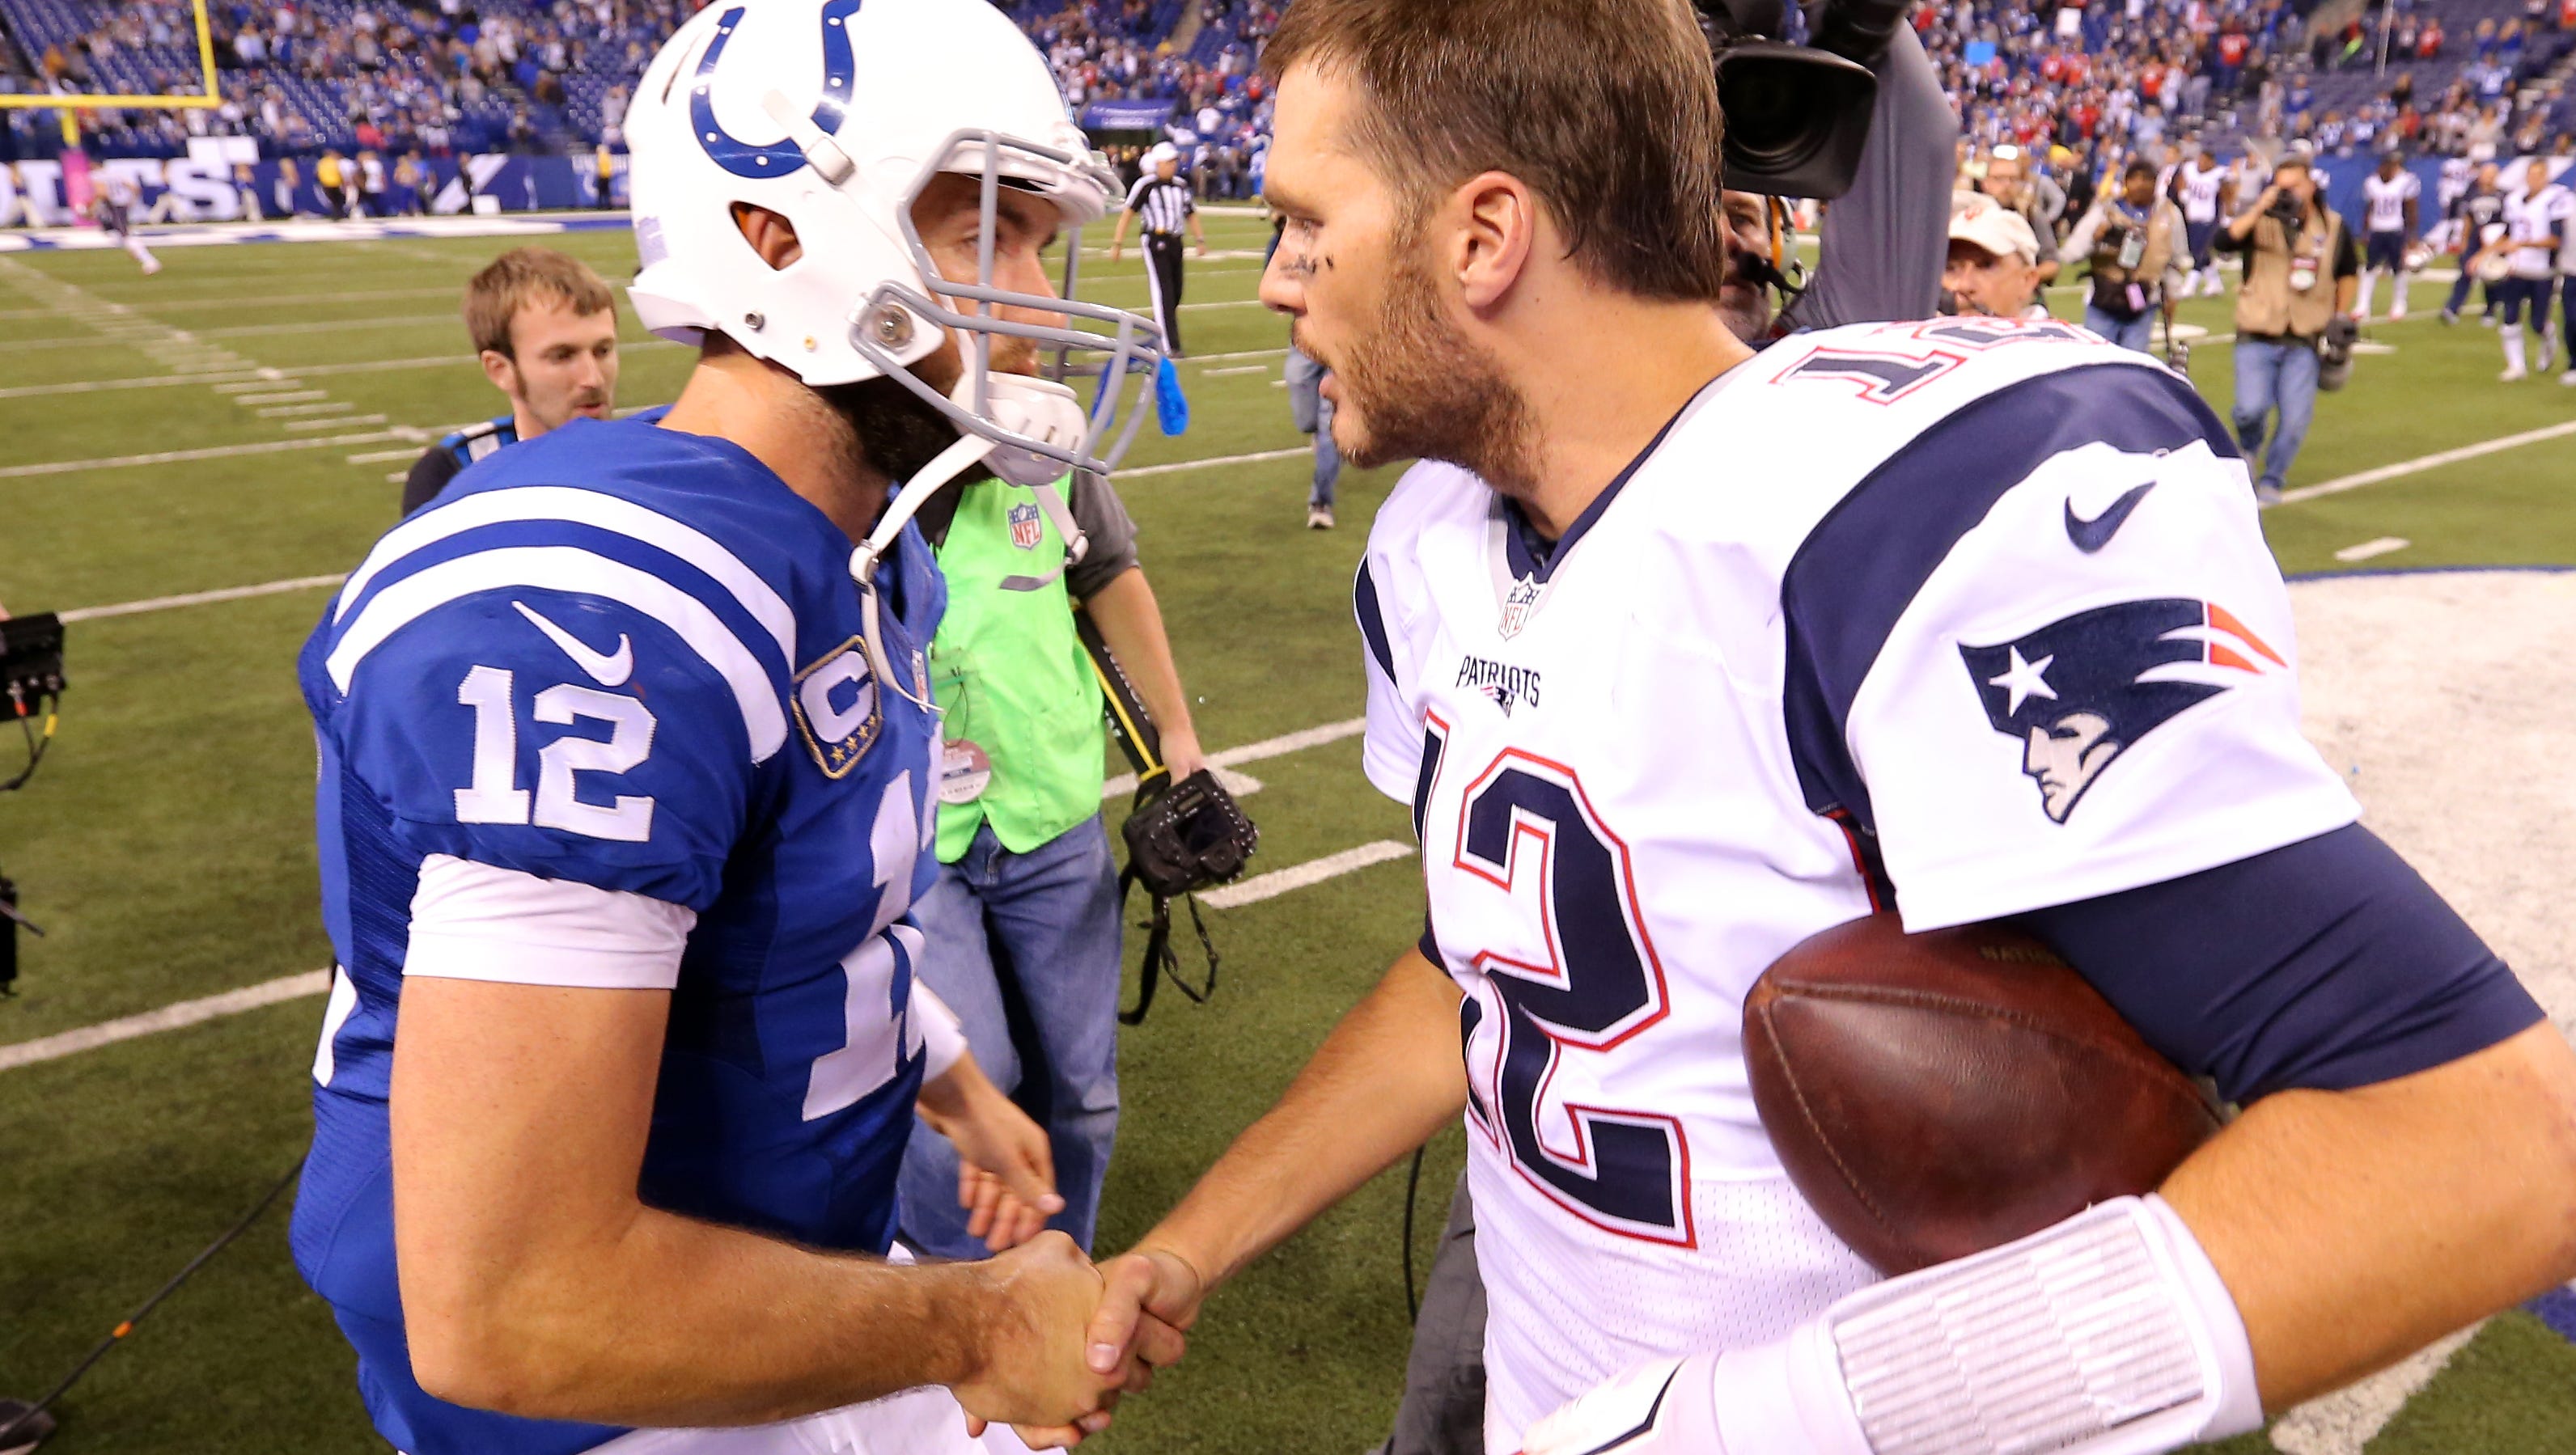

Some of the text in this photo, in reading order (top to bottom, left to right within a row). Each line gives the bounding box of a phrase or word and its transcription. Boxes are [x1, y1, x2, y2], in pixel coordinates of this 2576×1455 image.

[0, 159, 241, 226] LTS
[1013, 522, 1040, 544] NFL
[1501, 606, 1523, 633] NFL
[800, 650, 875, 743] C
[1455, 654, 1541, 708] PATRIOTS
[455, 665, 657, 842] 12
